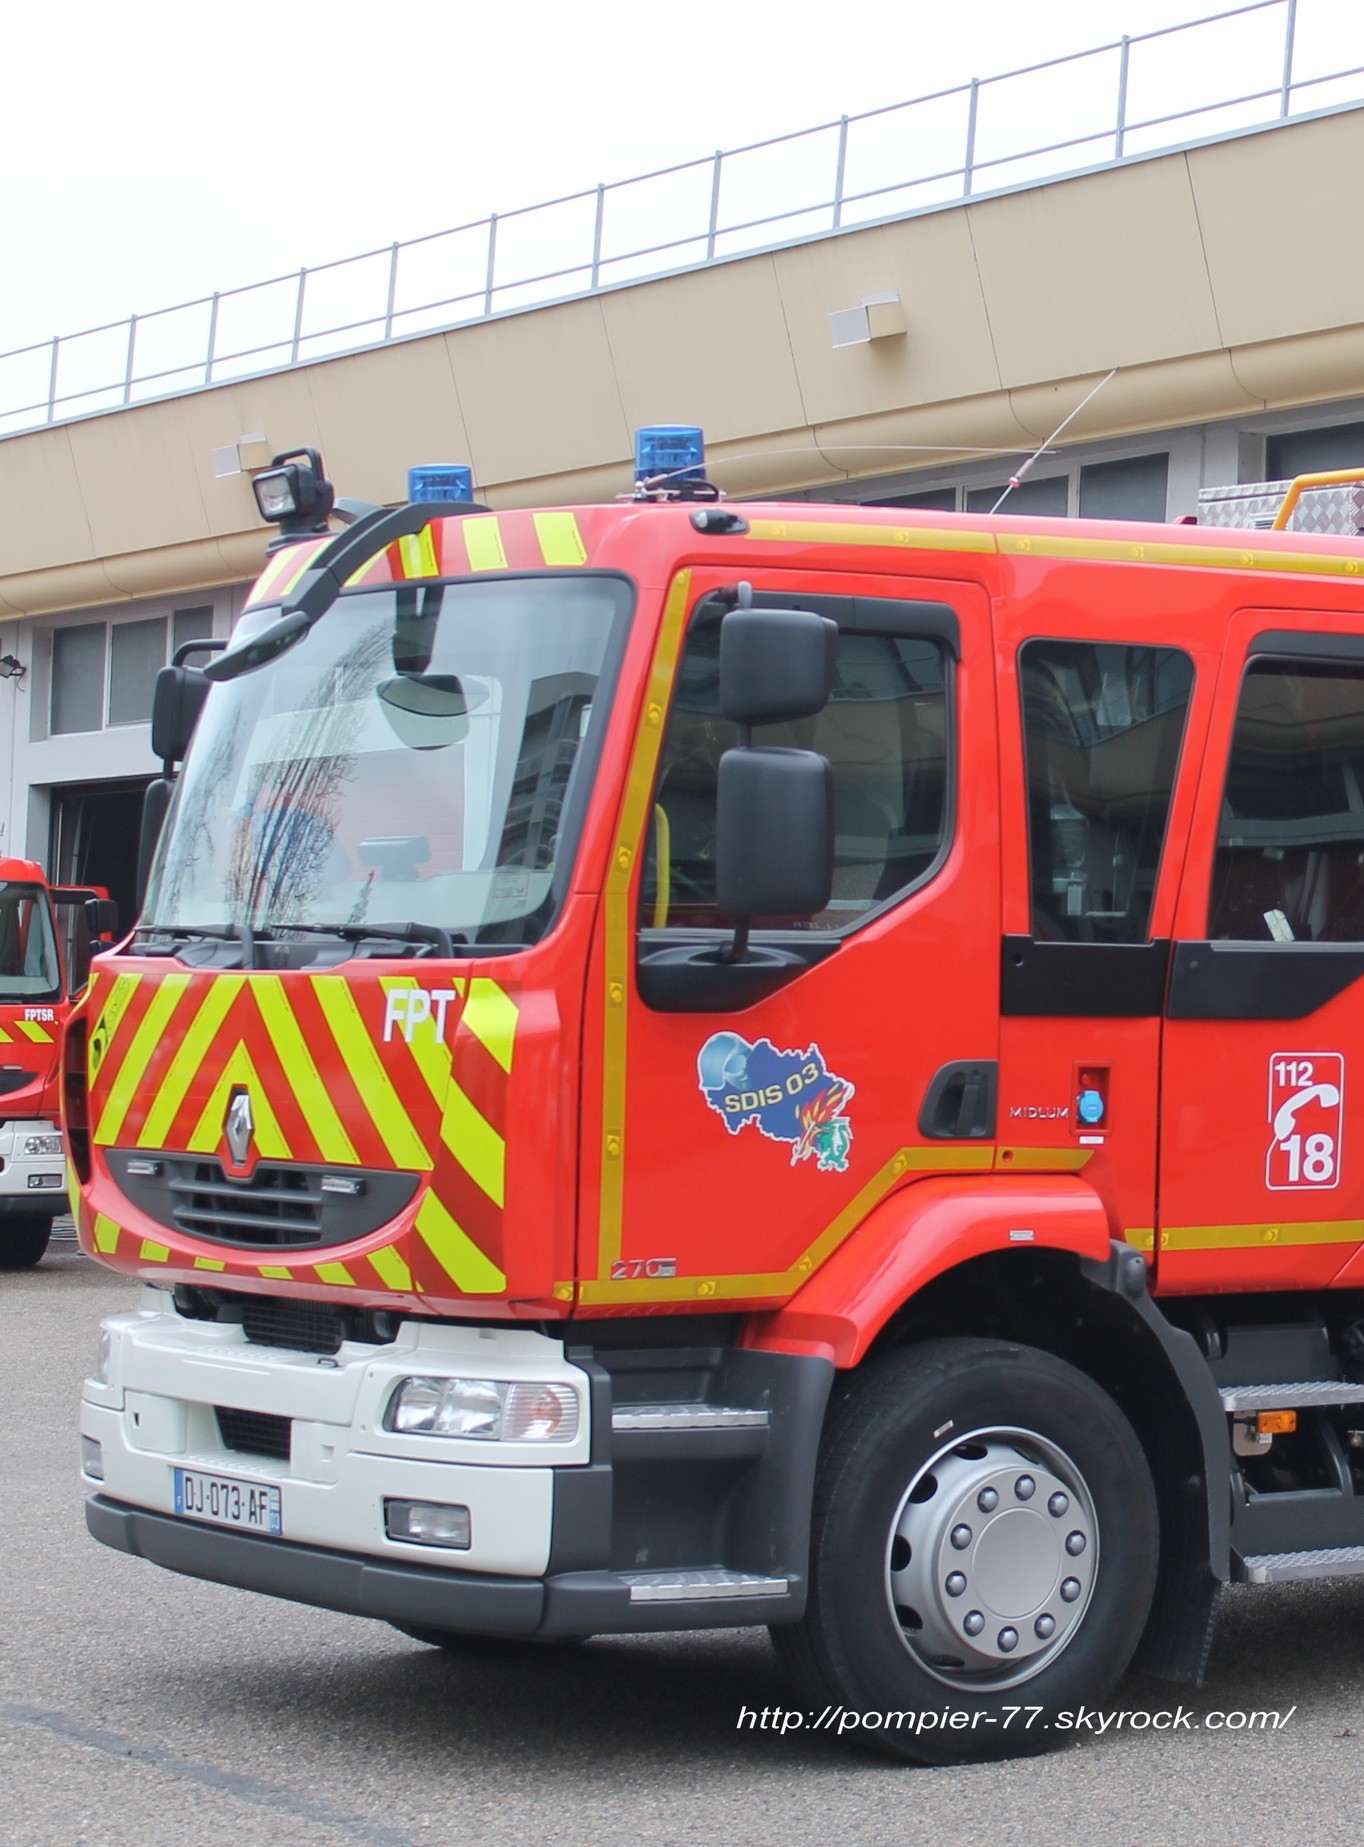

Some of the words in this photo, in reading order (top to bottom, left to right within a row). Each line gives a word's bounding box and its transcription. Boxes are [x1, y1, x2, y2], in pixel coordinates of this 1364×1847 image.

[24, 1008, 54, 1022] FPTSR
[383, 988, 456, 1043] FPT
[724, 1084, 784, 1113] SDIS
[786, 1062, 819, 1095] 03
[1274, 1061, 1314, 1087] 112
[1009, 1106, 1069, 1118] MIDLUM
[1279, 1133, 1335, 1182] 18
[611, 1258, 662, 1279] 270
[185, 1476, 268, 1525] DJ-073-AF
